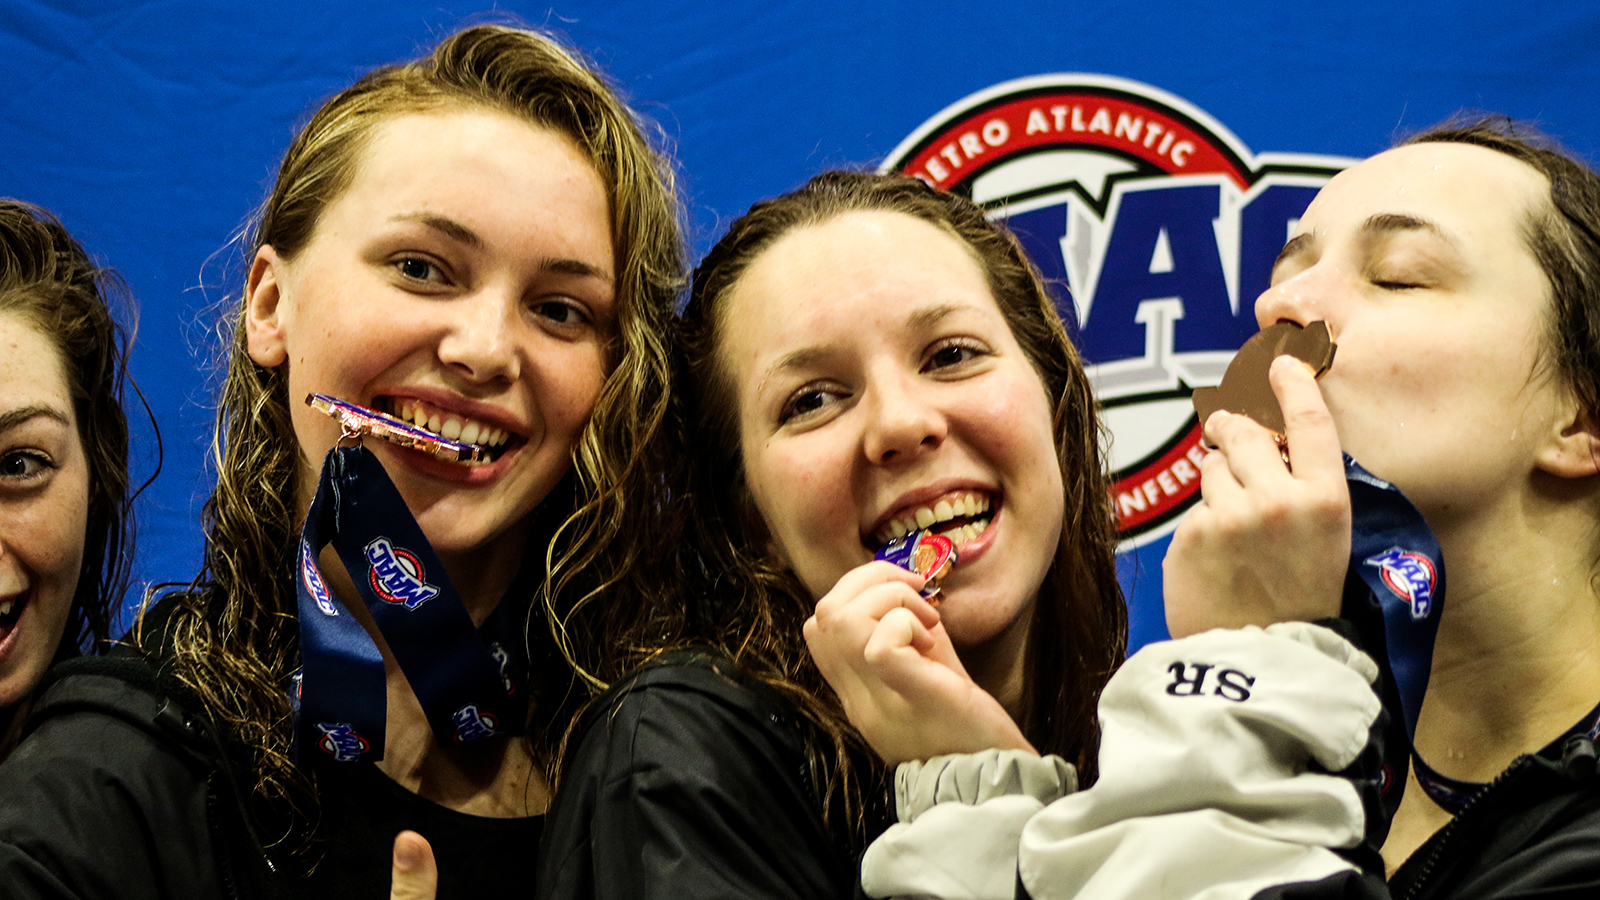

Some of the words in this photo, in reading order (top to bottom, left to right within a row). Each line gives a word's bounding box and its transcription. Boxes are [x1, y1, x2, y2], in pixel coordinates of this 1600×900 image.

[1025, 105, 1196, 168] ATLANTIC
[366, 538, 437, 610] MAAC
[1366, 549, 1431, 617] MAAC
[1165, 660, 1256, 702] SR
